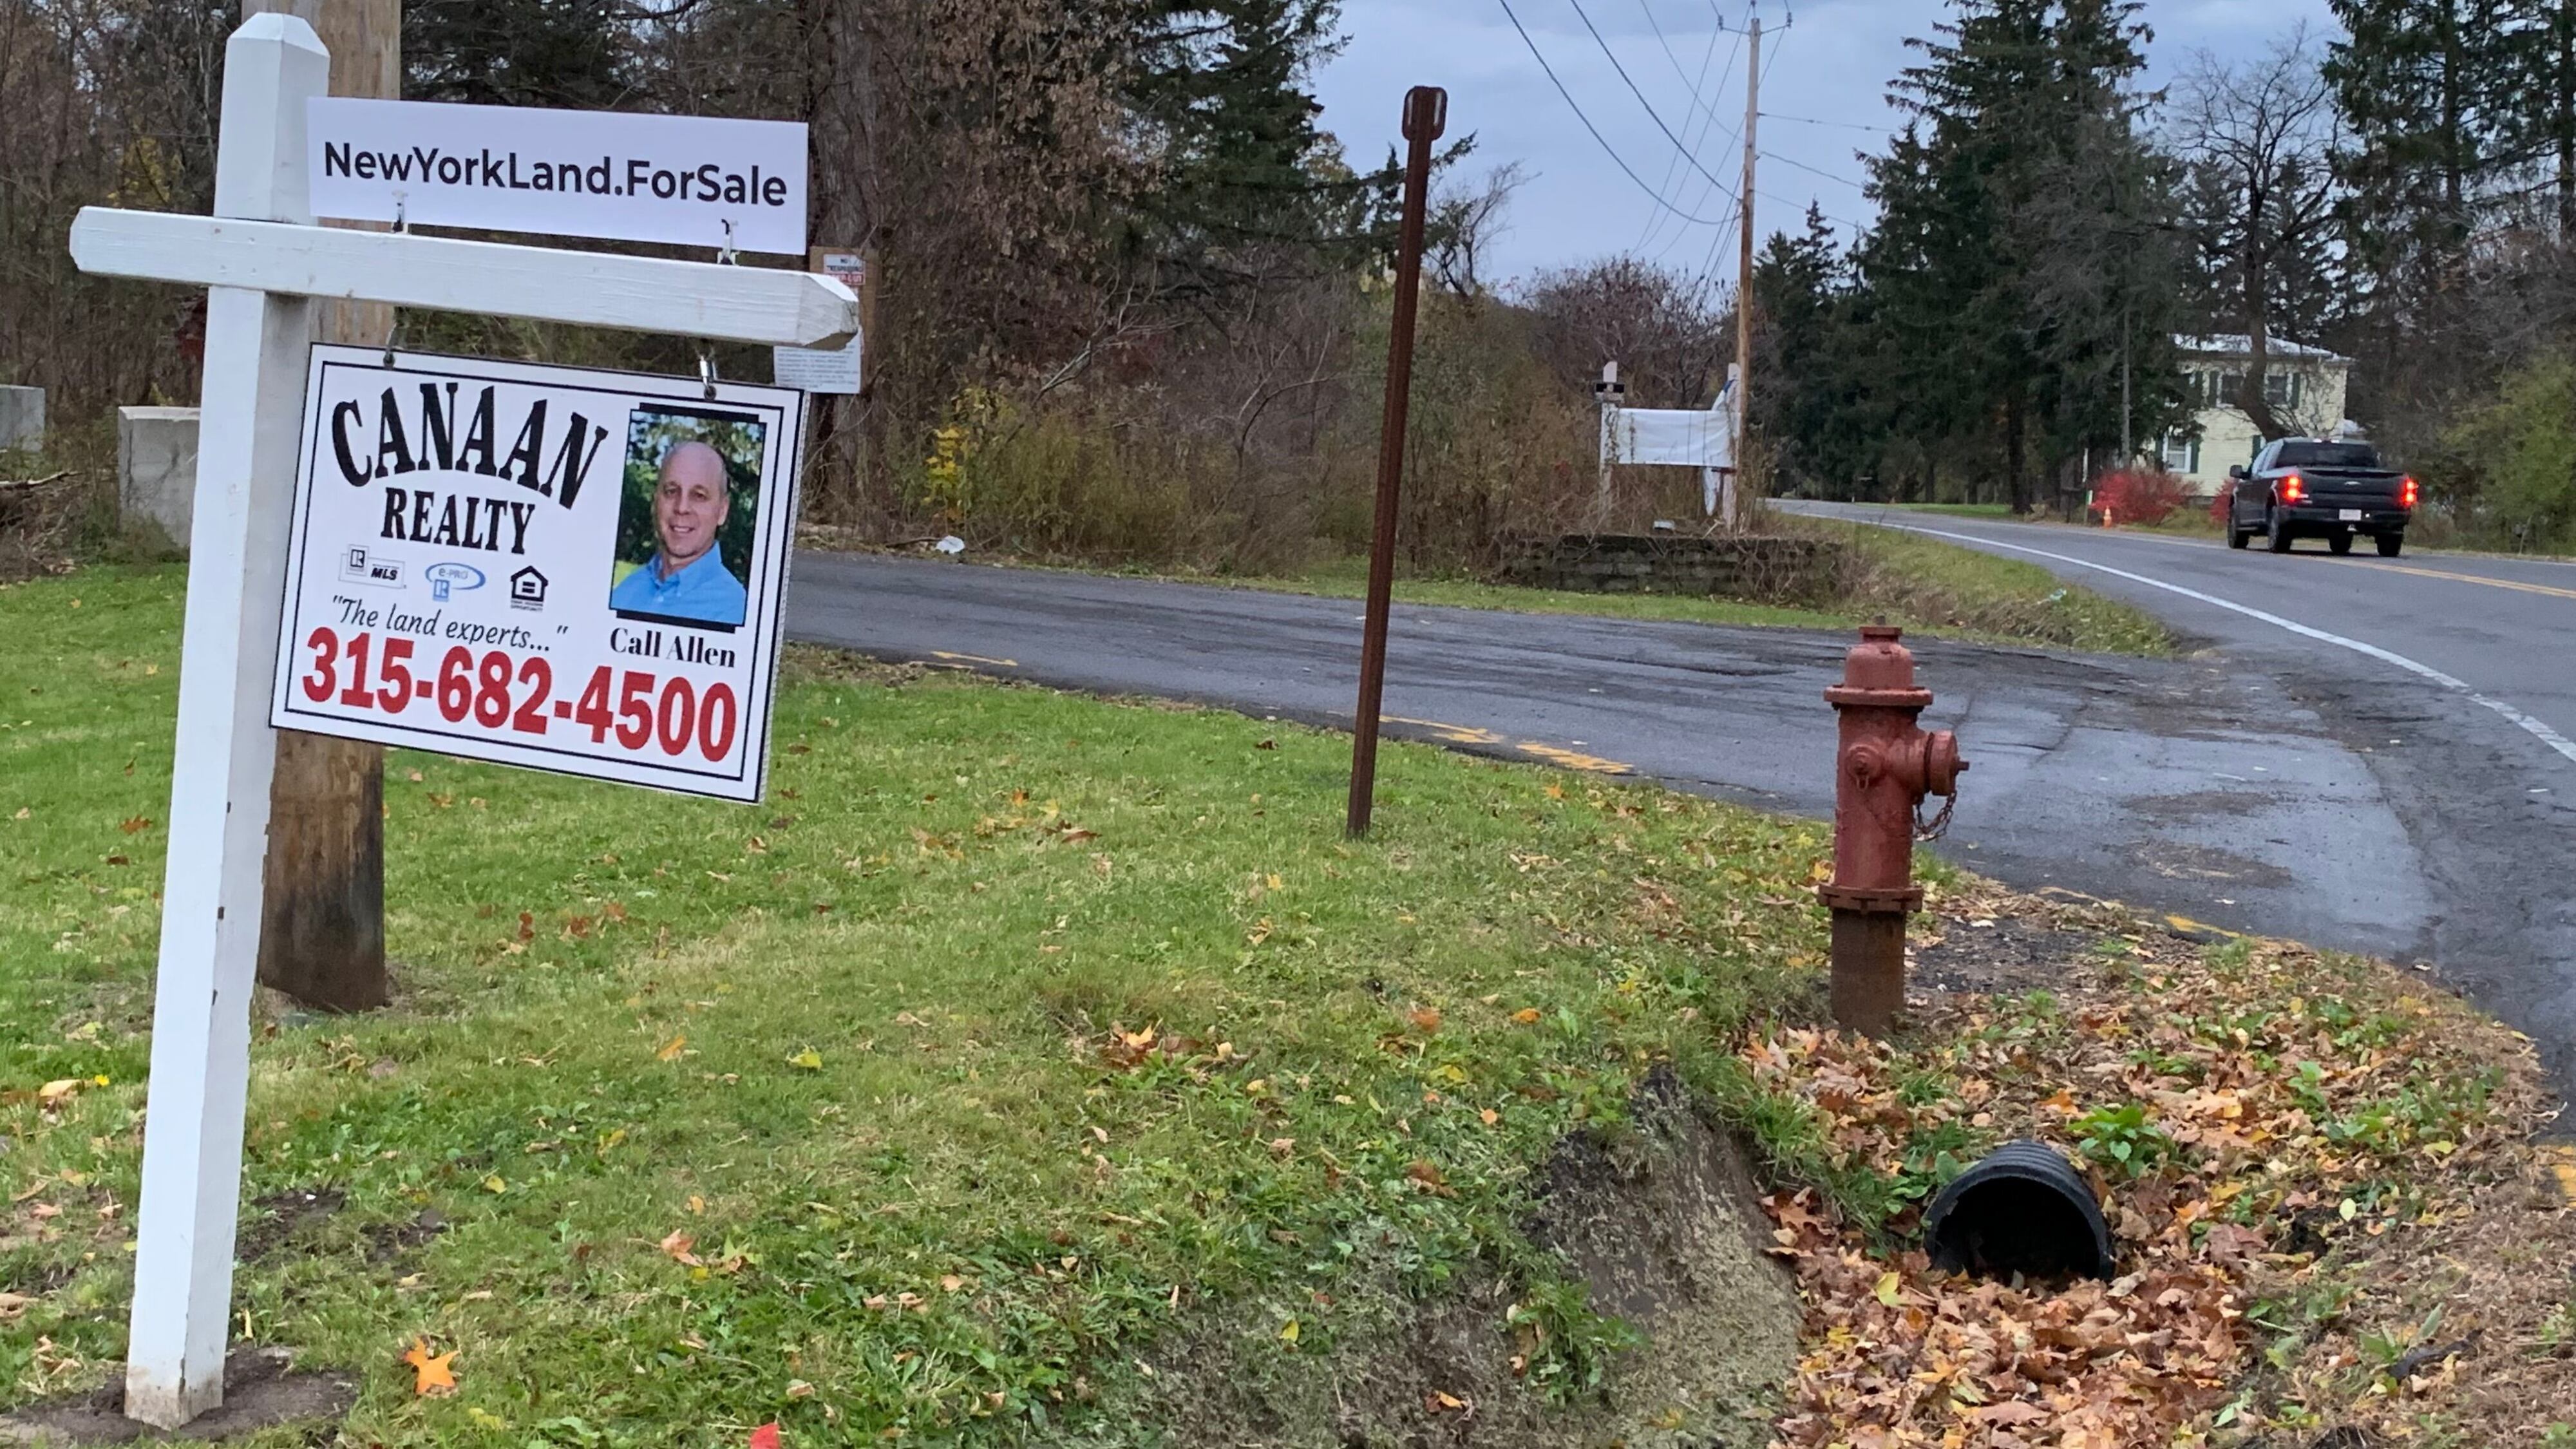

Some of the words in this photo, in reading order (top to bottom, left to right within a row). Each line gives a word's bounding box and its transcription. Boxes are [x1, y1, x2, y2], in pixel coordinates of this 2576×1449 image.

[325, 141, 787, 207] NewYorkLand.ForSale
[332, 382, 609, 510] CANAAN
[381, 487, 536, 555] REALTY
[371, 567, 398, 580] MLS
[333, 594, 379, 628] "The
[386, 603, 442, 636] land
[610, 627, 661, 658] Call
[666, 635, 735, 668] Allen
[303, 627, 736, 761] 315-682-4500
